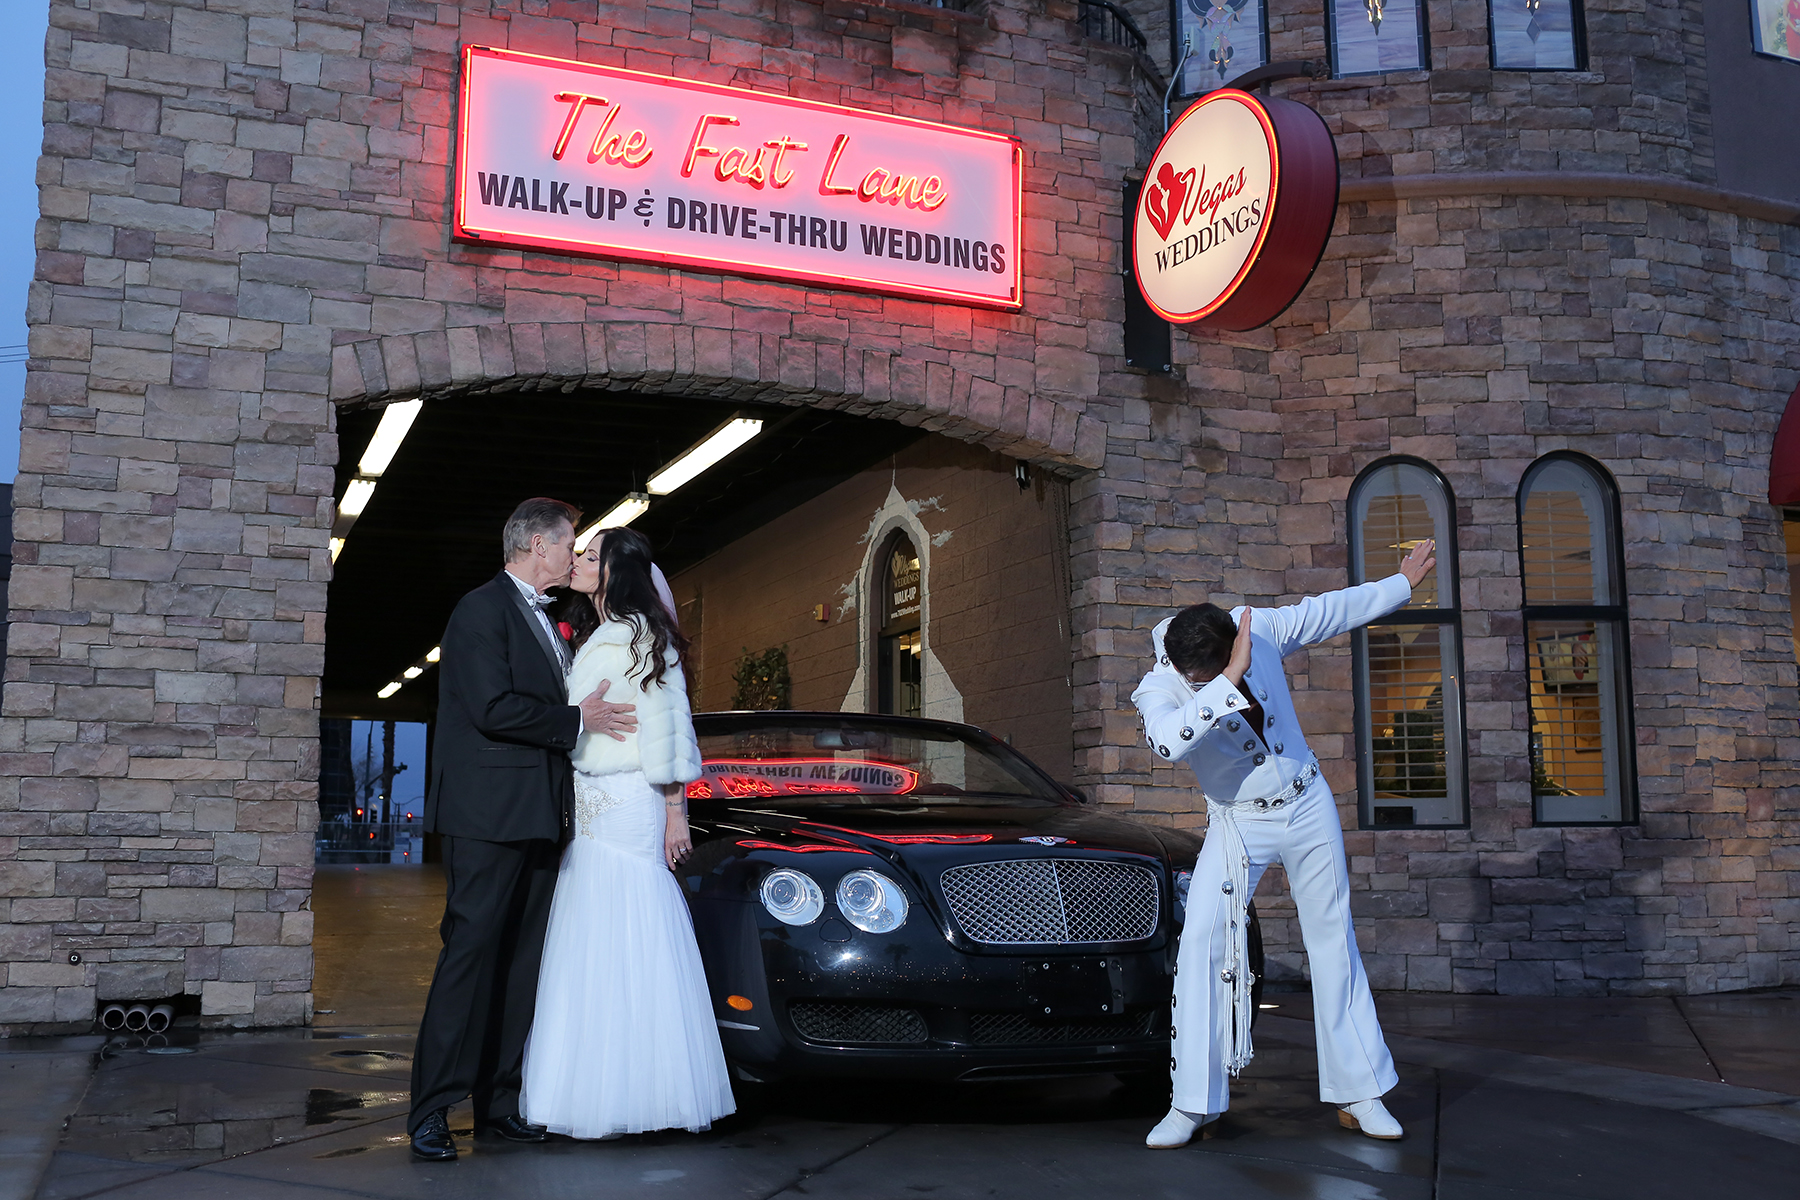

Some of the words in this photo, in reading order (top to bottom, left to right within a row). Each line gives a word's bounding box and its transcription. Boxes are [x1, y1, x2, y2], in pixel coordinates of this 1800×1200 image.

[553, 90, 654, 169] The
[681, 113, 809, 190] Fast
[818, 133, 948, 212] Lane
[477, 171, 628, 221] WALK-UP
[633, 188, 655, 227] &
[667, 196, 848, 252] DRIVE-THRU
[859, 223, 1006, 275] WEDDINGS
[1181, 163, 1248, 227] Vegas
[1154, 197, 1262, 275] WEDDINGS
[894, 586, 917, 605] WALK-UP
